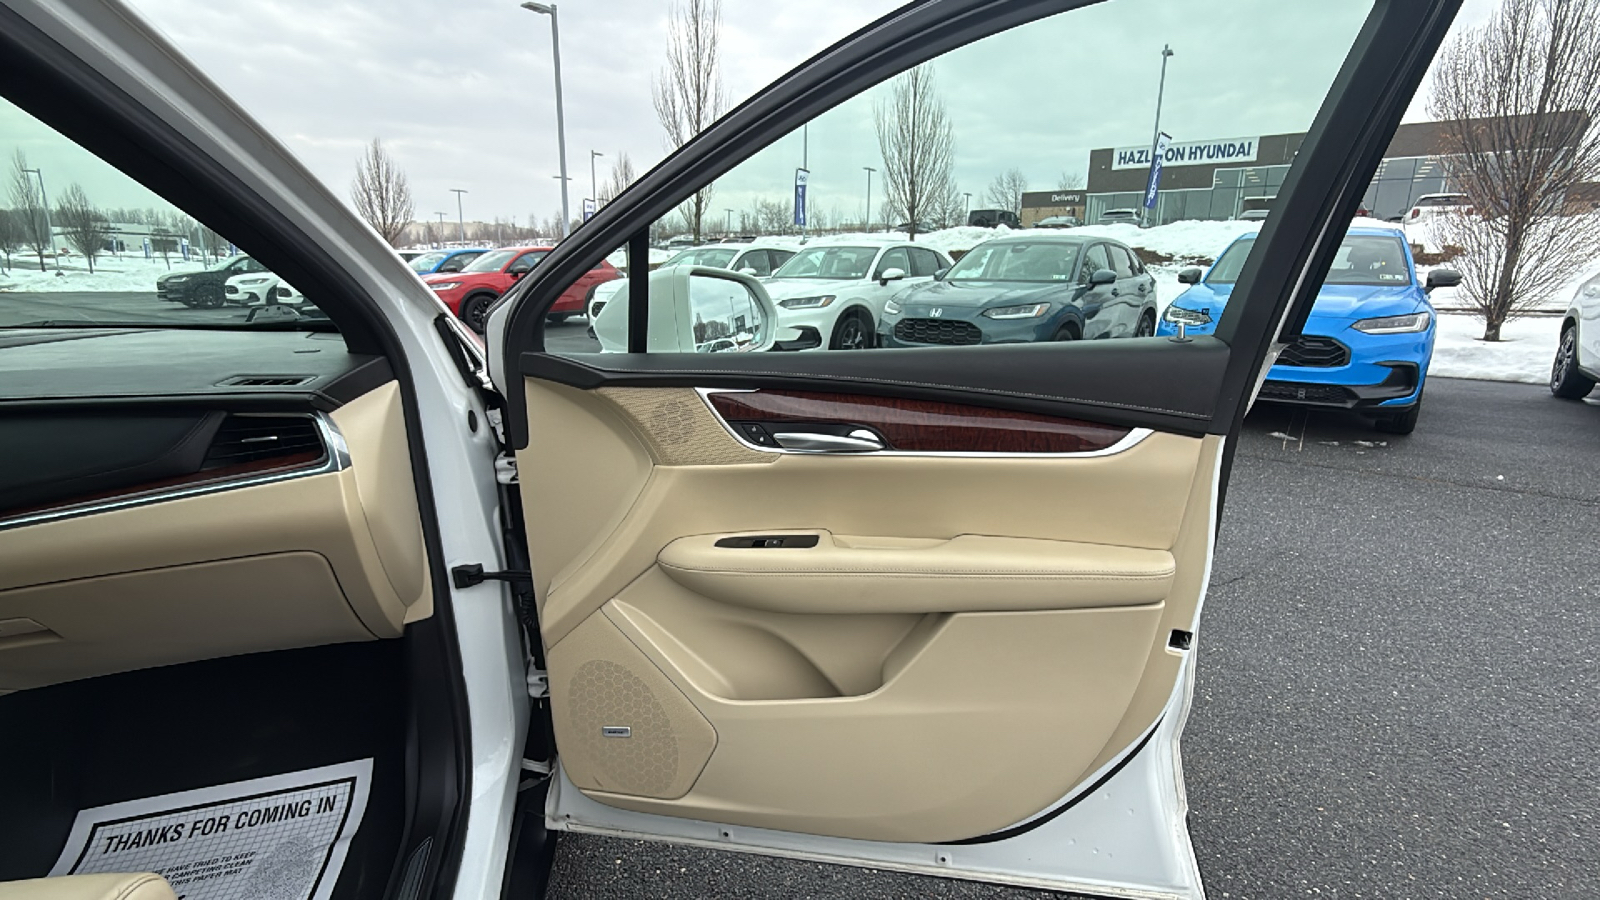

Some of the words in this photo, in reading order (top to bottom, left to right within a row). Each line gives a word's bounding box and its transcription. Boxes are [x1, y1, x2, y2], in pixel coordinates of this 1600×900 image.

[1118, 146, 1184, 165] HAZLON
[1188, 141, 1253, 160] HYUNDAI
[1051, 193, 1080, 203] Delivery
[103, 823, 184, 854] THANKS
[188, 815, 229, 839] FOR
[234, 800, 311, 830] COMING
[315, 795, 337, 813] IN
[167, 863, 191, 873] HAVE
[193, 858, 218, 868] TRIED
[234, 851, 256, 860] KEEP
[172, 865, 222, 879] CARPETING
[224, 859, 253, 869] CLEAN
[171, 877, 191, 886] THIS
[193, 871, 222, 882] PAPER
[224, 868, 242, 877] MAT
